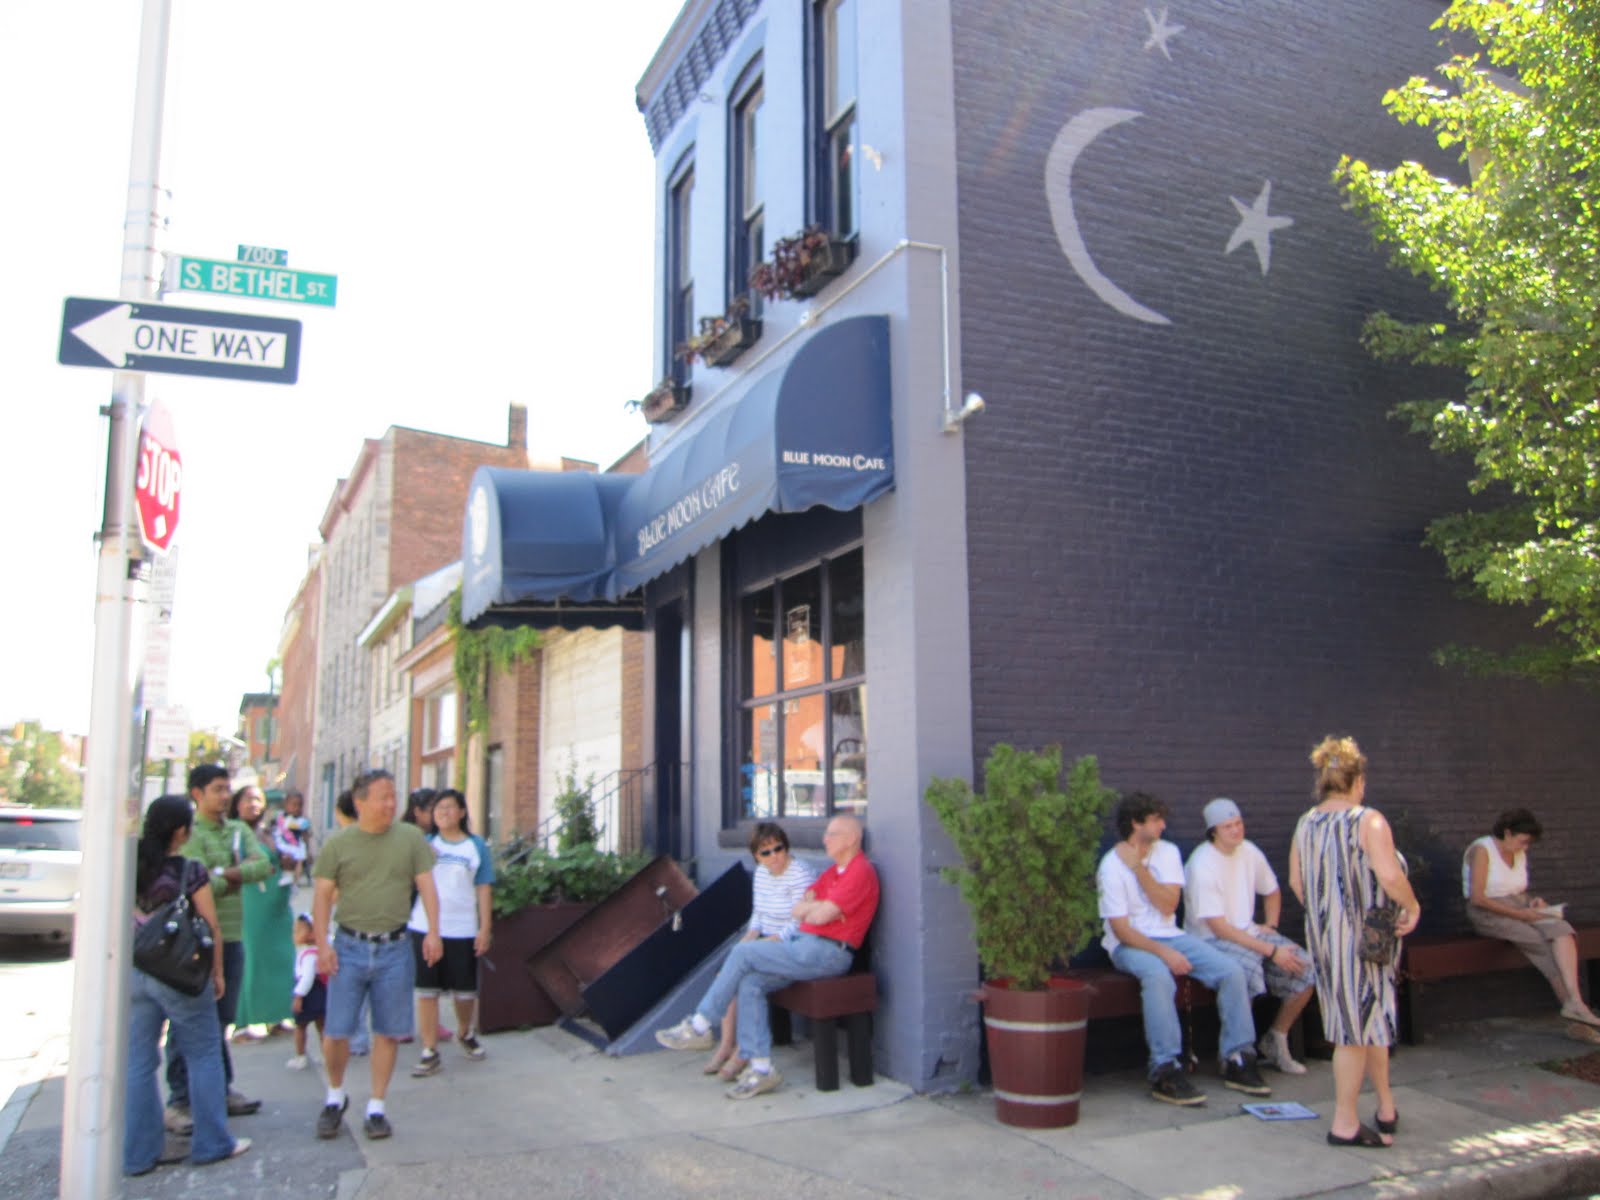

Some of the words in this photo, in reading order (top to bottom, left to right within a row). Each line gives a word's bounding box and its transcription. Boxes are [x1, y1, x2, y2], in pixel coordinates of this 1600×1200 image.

[243, 245, 276, 264] 700
[184, 262, 206, 290] S.
[211, 265, 305, 299] BETHEL
[134, 324, 198, 355] ONE
[211, 331, 275, 361] WAY
[138, 436, 181, 511] STOP
[783, 451, 809, 465] BLUE
[813, 453, 851, 468] MOON
[852, 455, 885, 471] CAFE
[667, 490, 701, 535] MOON
